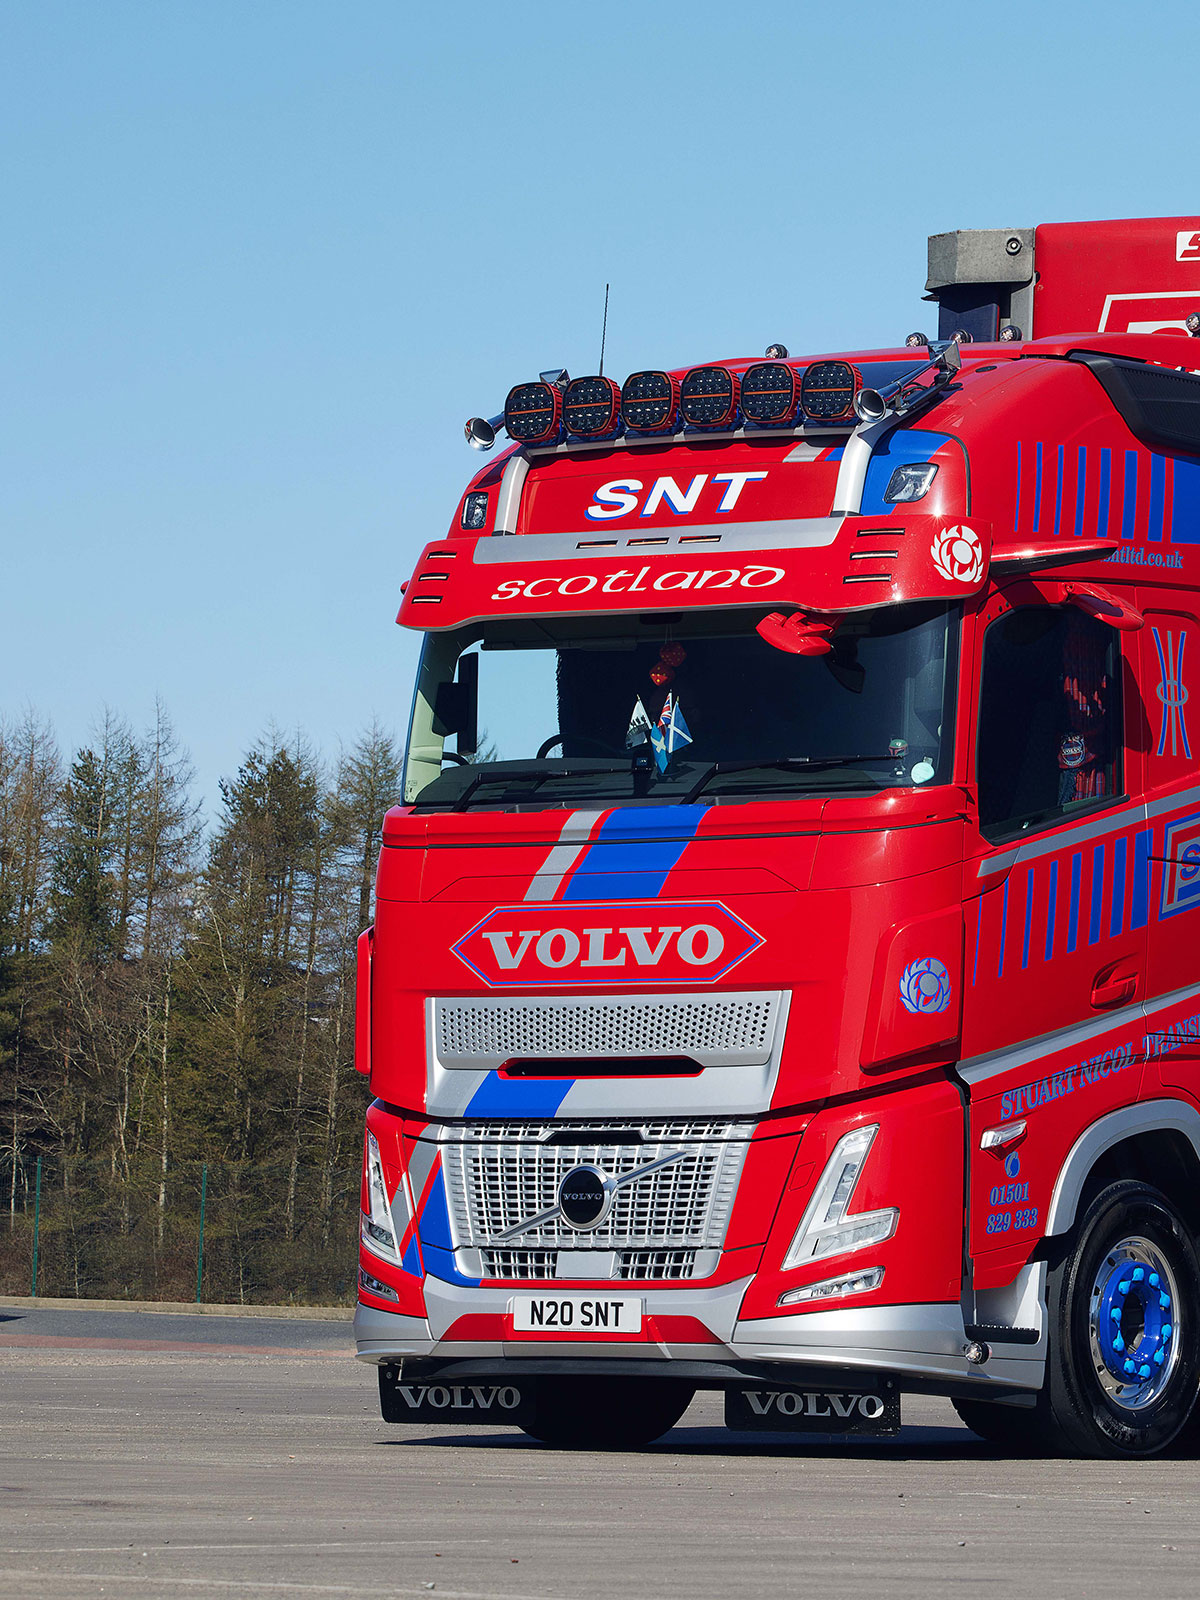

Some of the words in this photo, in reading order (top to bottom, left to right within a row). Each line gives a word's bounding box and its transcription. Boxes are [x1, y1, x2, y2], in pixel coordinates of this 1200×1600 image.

[585, 471, 769, 521] SNT
[1101, 546, 1184, 569] ntltd.co.uk
[482, 924, 725, 969] VOLVO
[1000, 1067, 1077, 1121] STUART
[1079, 1049, 1137, 1086] NICOL
[562, 1192, 603, 1201] VOLVO
[989, 1181, 1030, 1207] 01501
[986, 1210, 1012, 1234] 829
[1013, 1207, 1039, 1229] 333
[530, 1300, 574, 1326] N20
[580, 1301, 624, 1327] SNT
[395, 1385, 522, 1410] VOLVO
[742, 1390, 884, 1419] VOLVO
